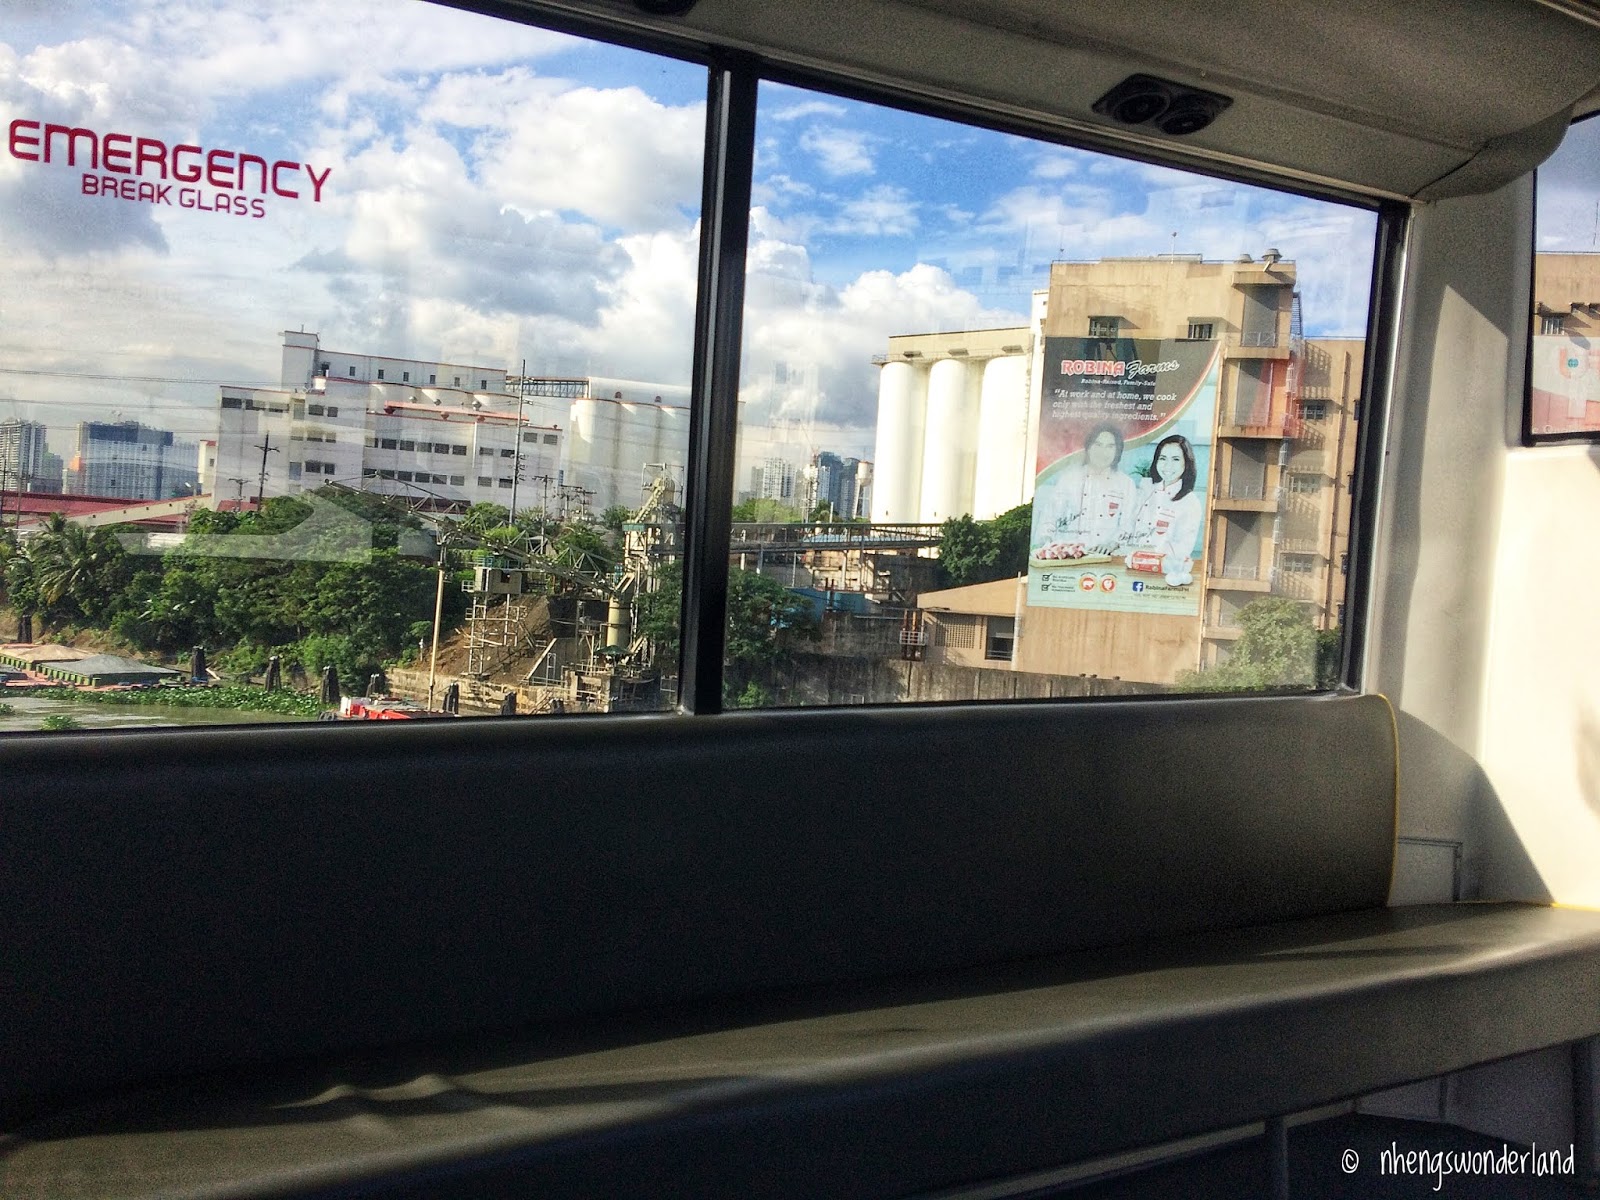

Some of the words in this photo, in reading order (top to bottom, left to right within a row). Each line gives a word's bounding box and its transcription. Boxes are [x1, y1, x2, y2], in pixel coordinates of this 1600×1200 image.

[9, 119, 332, 202] EMERGENCY
[82, 173, 172, 206] BREAK
[179, 188, 266, 218] GLASS
[1061, 360, 1125, 377] ROBINA
[1126, 360, 1179, 379] Farms
[1070, 390, 1090, 398] work
[1091, 391, 1107, 399] and
[1117, 392, 1141, 401] home,
[1156, 393, 1177, 401] cook
[1104, 402, 1136, 410] freshest
[1137, 403, 1153, 411] and
